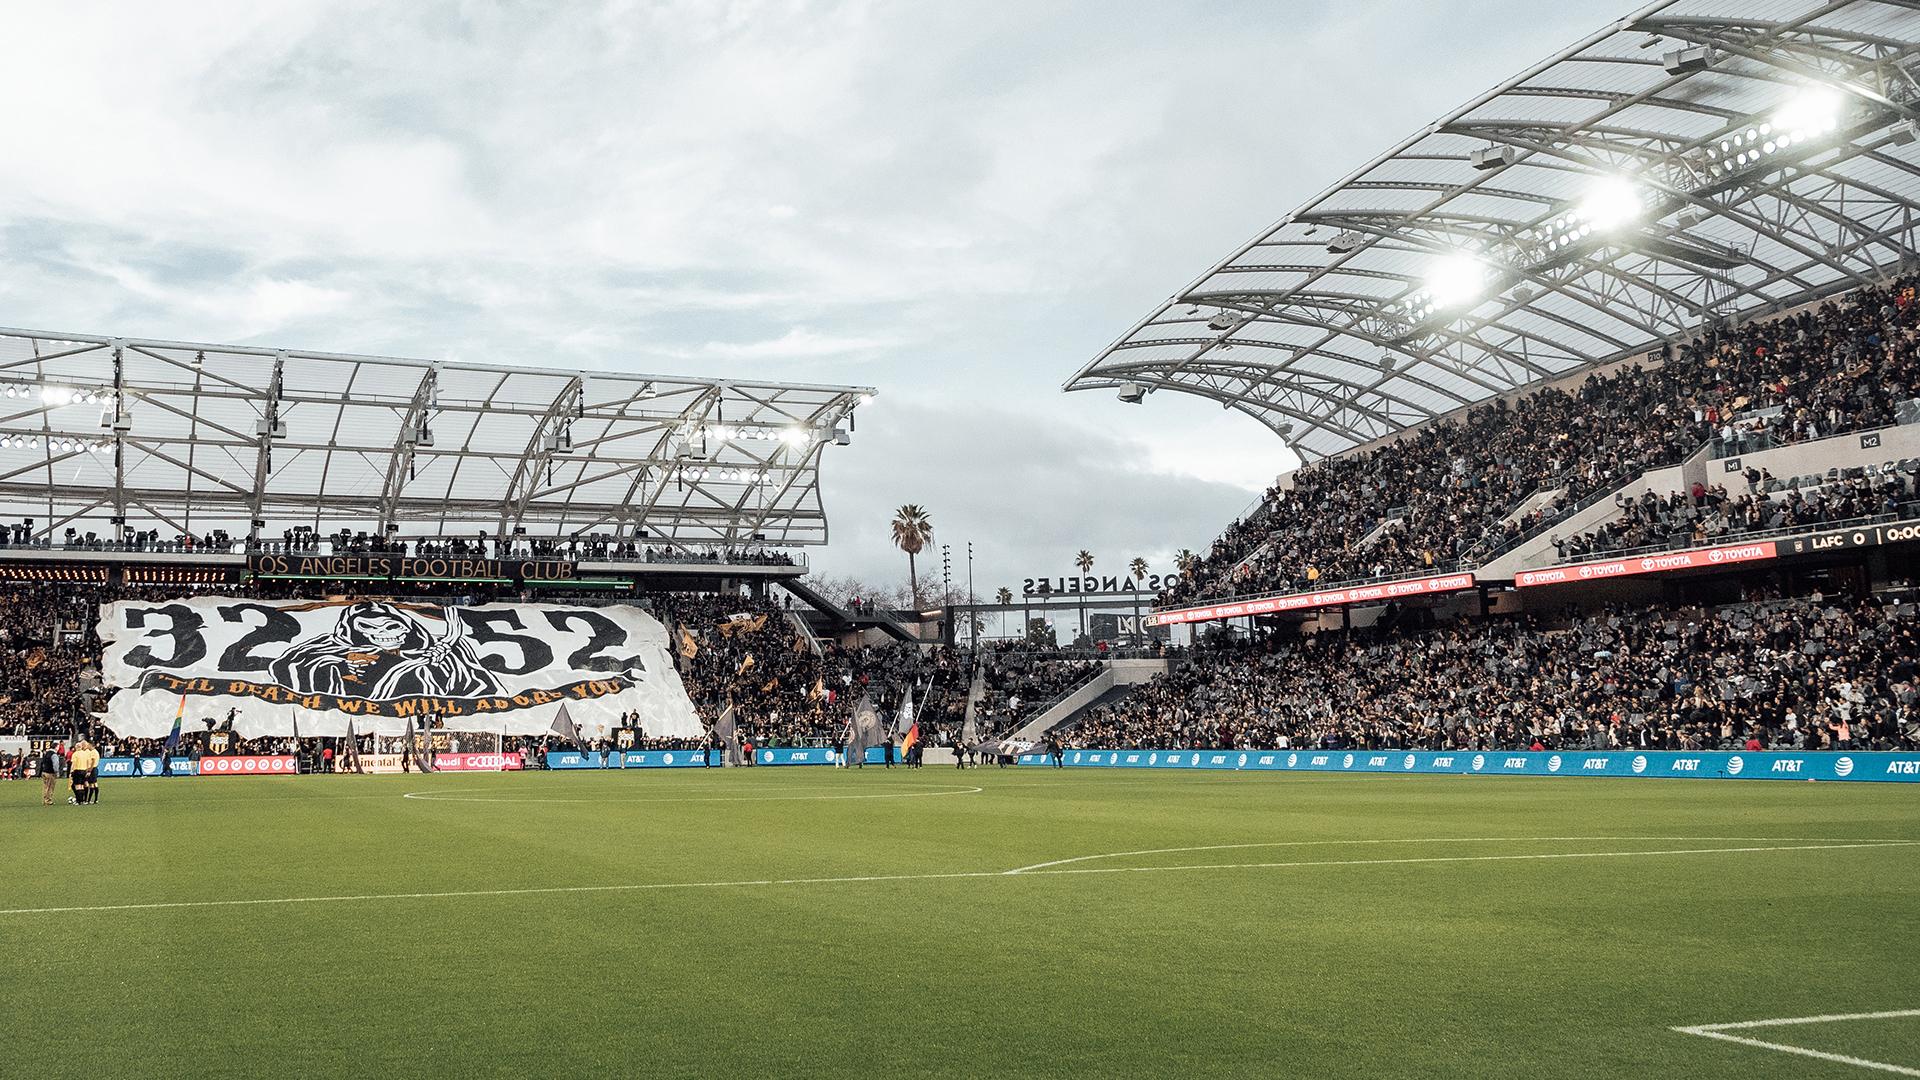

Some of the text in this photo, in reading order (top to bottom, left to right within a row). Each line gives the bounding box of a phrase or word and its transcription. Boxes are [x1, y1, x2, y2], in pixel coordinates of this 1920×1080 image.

[1863, 437, 1878, 447] M2
[1727, 462, 1738, 471] M1
[1812, 535, 1843, 549] LAFC
[1853, 533, 1865, 545] 0
[248, 555, 572, 580] LOS ANGELES FOOTBALL CLUB
[1535, 547, 1763, 582] TOYOTA TOYOTA TOYOTA TOYOTA
[1222, 606, 1242, 615] TOYOTA
[1254, 602, 1274, 611] TOYOTA
[1286, 596, 1308, 606] TOYOTA
[1322, 593, 1344, 603] TOYOTA
[1358, 588, 1382, 598] TOYOTA
[1396, 583, 1423, 593] TOYOTA
[1439, 577, 1467, 587] TOYOTA
[228, 682, 321, 708] DEATH
[336, 698, 381, 713] WE
[392, 698, 463, 717] WILL
[572, 680, 621, 699] YOU
[435, 757, 461, 767] Audi
[561, 756, 580, 764] AT&T
[791, 752, 808, 760] AT&T
[104, 762, 129, 772] AT&T
[1167, 755, 1181, 763] AT&T
[1211, 756, 1226, 764] AT&T
[1259, 756, 1275, 764] AT&T
[1311, 756, 1328, 765] AT&T
[1369, 757, 1387, 766] AT&T
[1433, 757, 1454, 767] AT&T
[1504, 758, 1527, 768] AT&T
[1583, 759, 1608, 769] AT&T
[1672, 759, 1700, 771] AT&T
[1772, 760, 1804, 772] AT&T
[1886, 761, 1920, 774] AT&T
